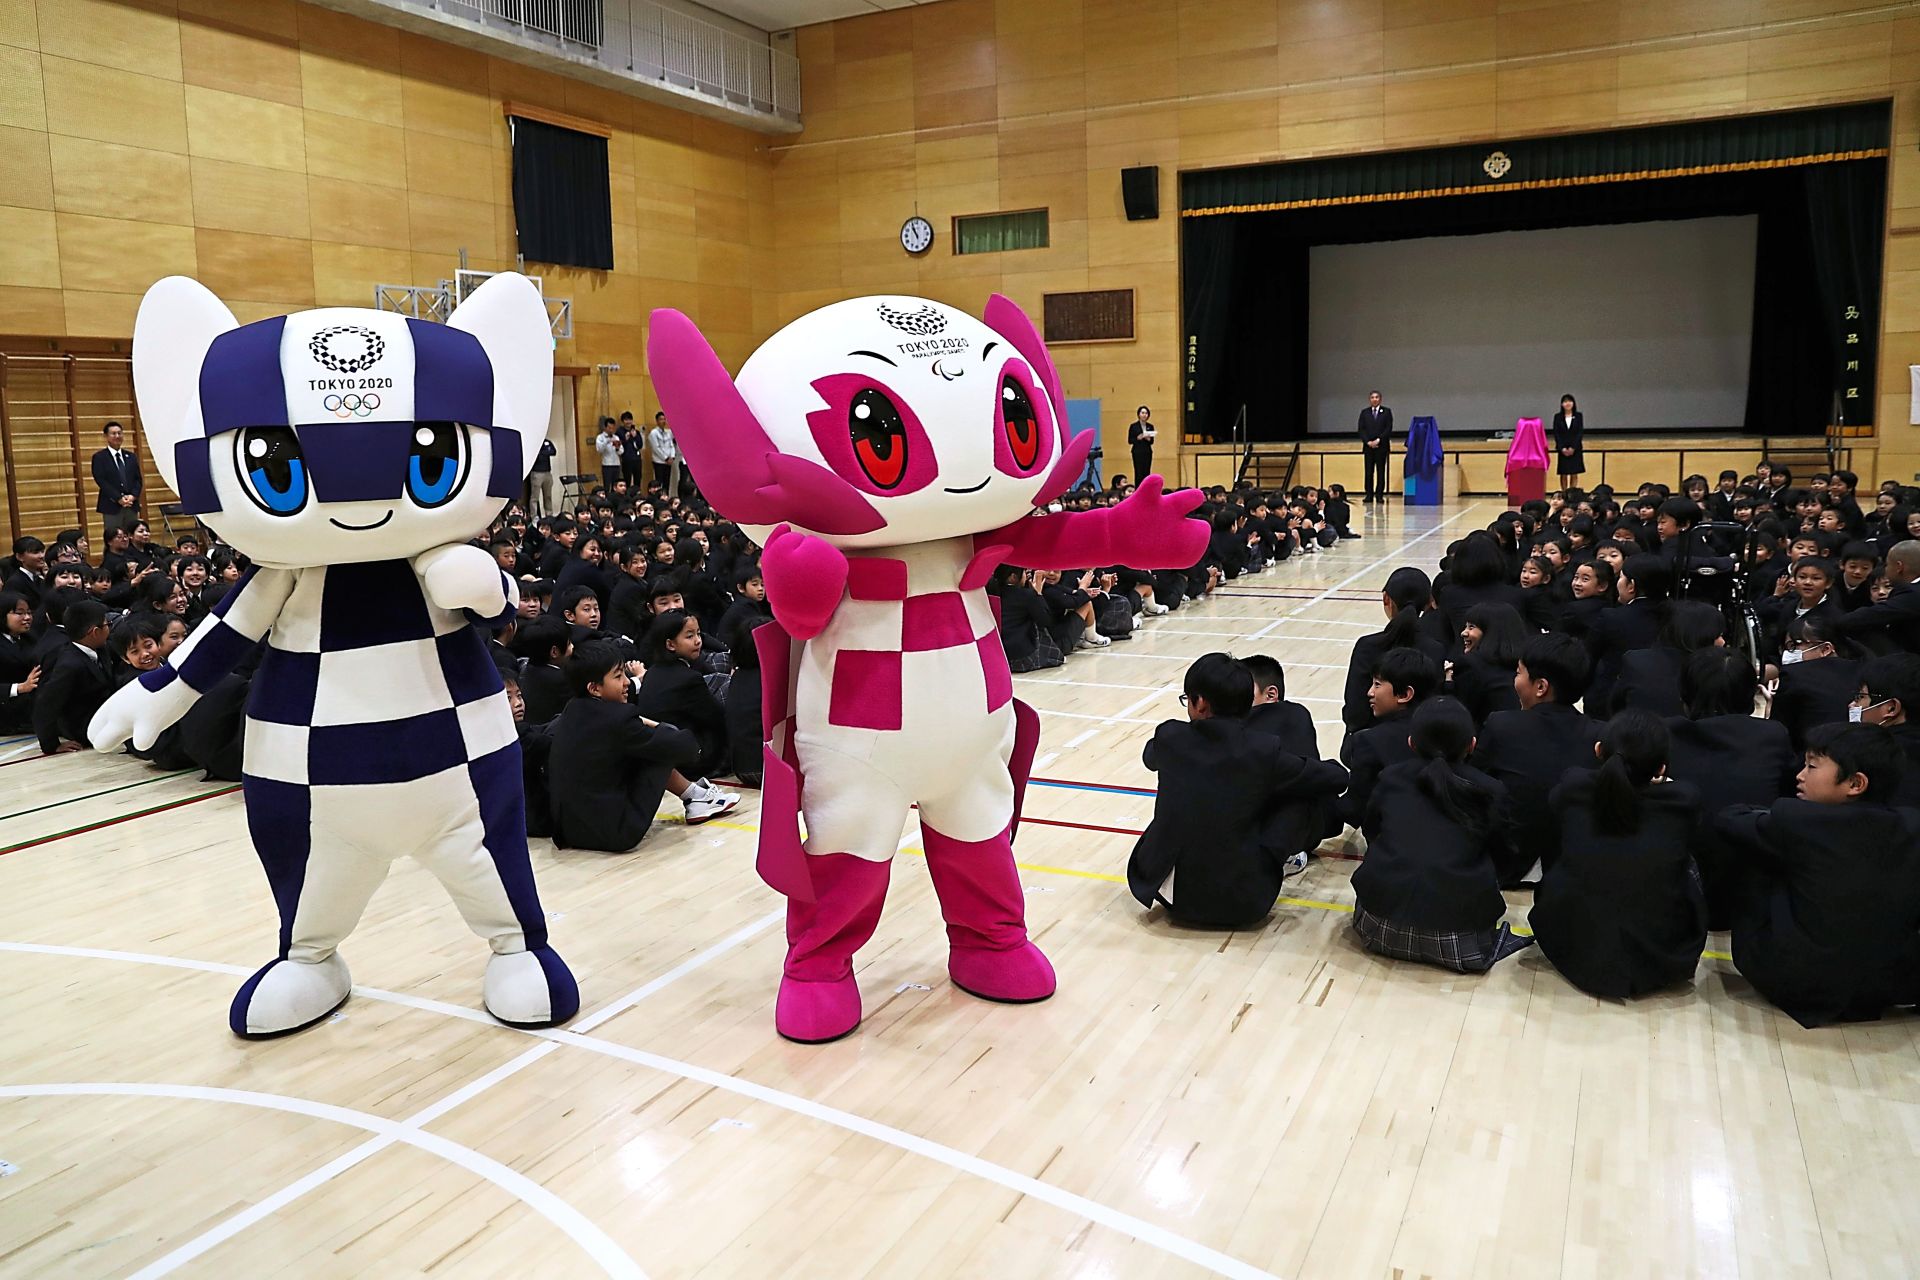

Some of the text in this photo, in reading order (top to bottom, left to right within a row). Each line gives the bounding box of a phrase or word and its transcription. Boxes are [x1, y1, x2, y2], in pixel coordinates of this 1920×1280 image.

[897, 338, 969, 354] TOKYO 2020
[308, 377, 393, 390] TOKYO 2020
